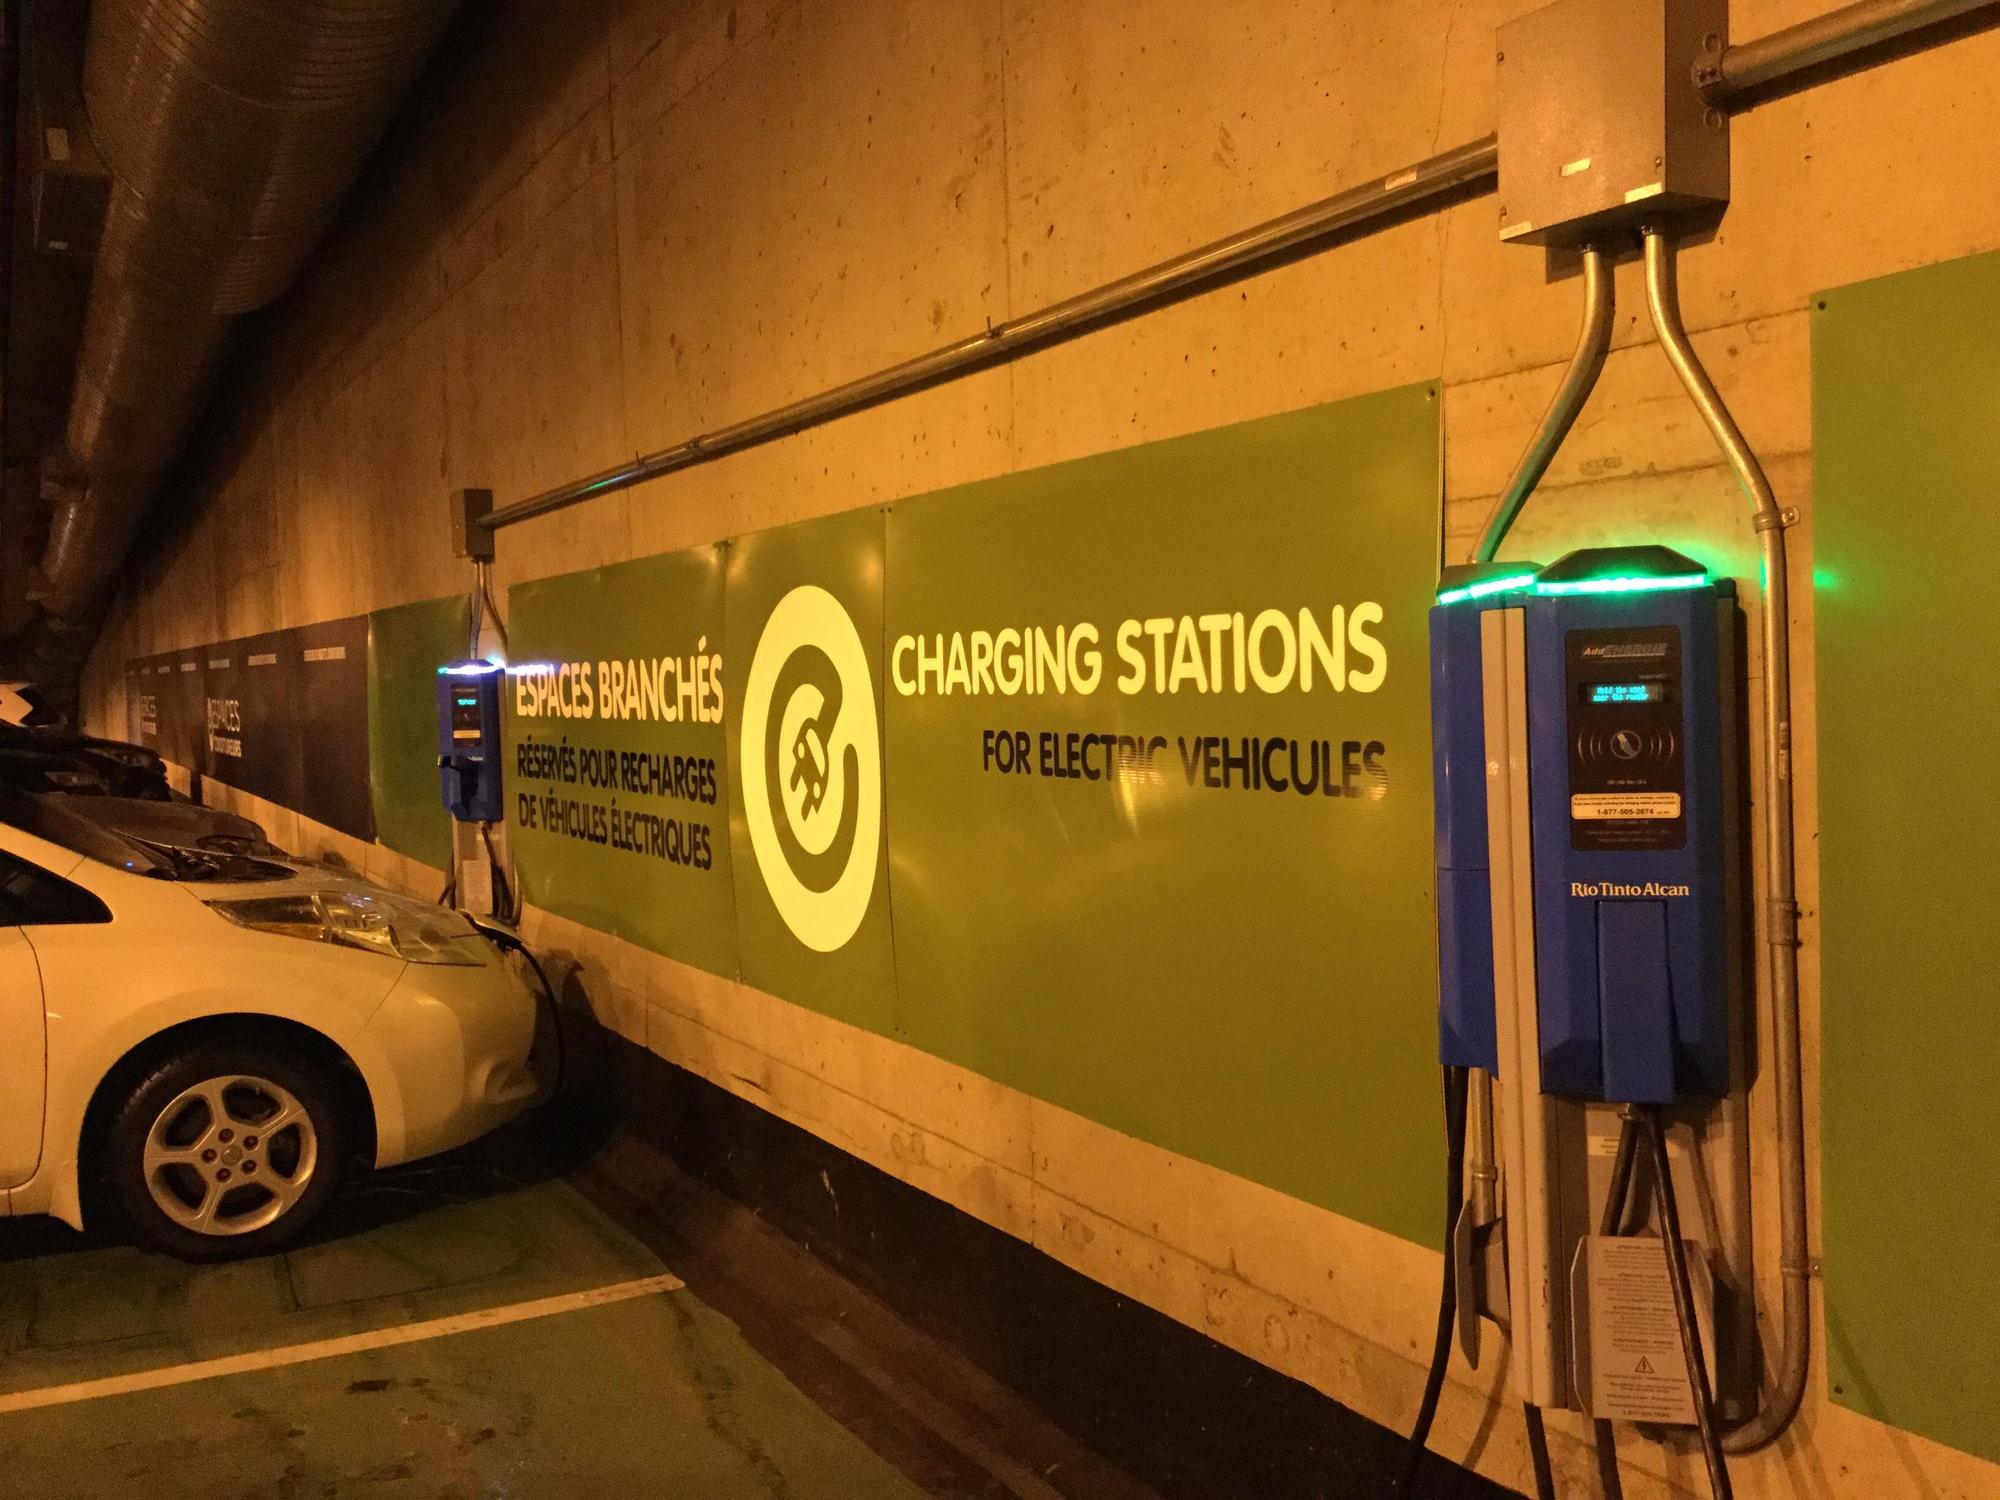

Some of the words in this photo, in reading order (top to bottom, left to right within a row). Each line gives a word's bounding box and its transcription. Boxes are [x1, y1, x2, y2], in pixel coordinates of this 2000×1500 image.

[516, 661, 594, 720] ESPACES
[599, 635, 724, 724] BRANCHÉS
[892, 622, 1102, 696] CHARGING
[1116, 601, 1388, 694] STATIONS
[517, 735, 577, 783] RÉSERVÉS
[580, 749, 617, 789] POUR
[621, 751, 717, 805] RECHARGES
[983, 729, 1031, 775] FOR
[1040, 732, 1167, 786] ELECTRIC
[1178, 736, 1389, 801] VEHICULES
[518, 792, 537, 827] DE
[540, 788, 608, 845] VÉHICULES
[611, 799, 712, 871] ÉLECTRIQUES
[1570, 882, 1599, 897] Rio
[1599, 882, 1641, 897] Tinto
[1643, 882, 1690, 897] Alcan
